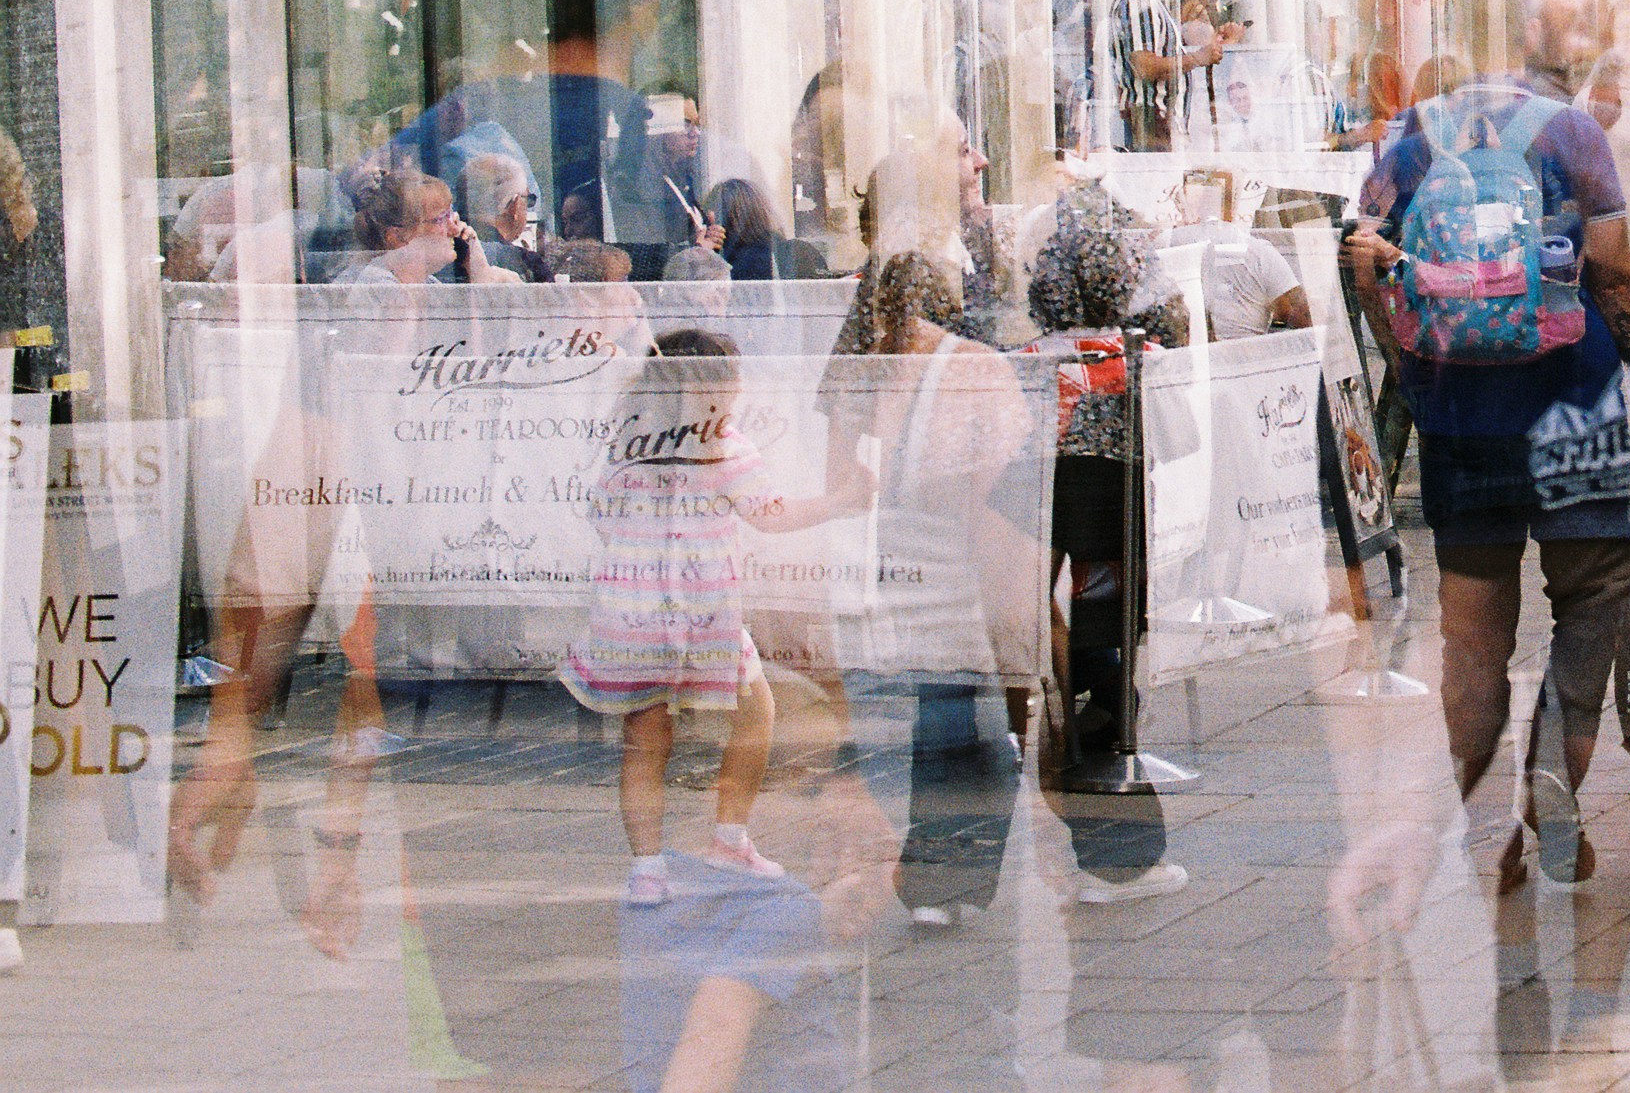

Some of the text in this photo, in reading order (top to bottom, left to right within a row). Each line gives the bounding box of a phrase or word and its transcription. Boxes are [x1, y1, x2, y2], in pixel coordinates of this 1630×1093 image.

[398, 328, 606, 396] Harriets
[406, 475, 494, 505] Lunch
[503, 475, 529, 504] &
[723, 552, 861, 583] Afternoon
[877, 554, 924, 583] Tea
[22, 594, 118, 642] WE
[7, 658, 130, 709] BUY
[27, 724, 149, 776] OLD
